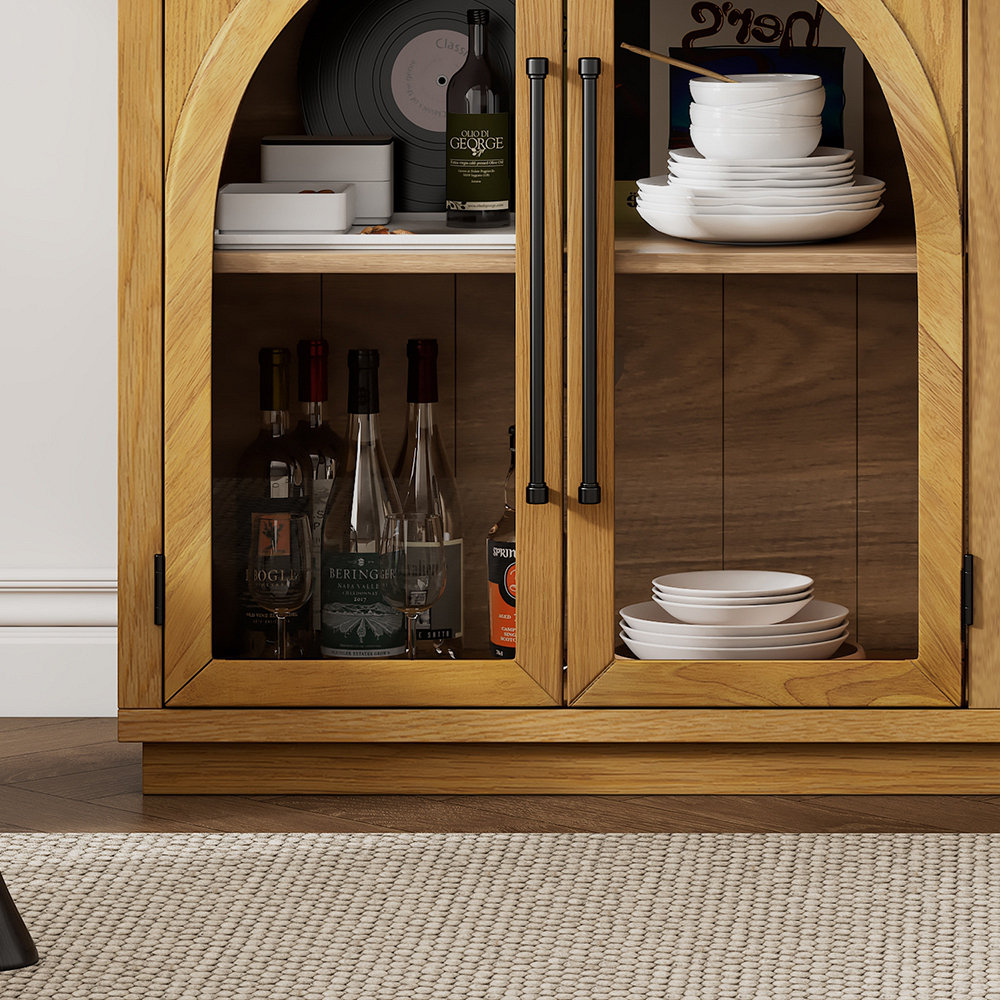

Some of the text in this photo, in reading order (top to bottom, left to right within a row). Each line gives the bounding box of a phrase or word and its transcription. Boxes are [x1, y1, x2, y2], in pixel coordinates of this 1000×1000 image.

[461, 130, 489, 138] OLIO DI
[450, 137, 504, 150] GEORGE
